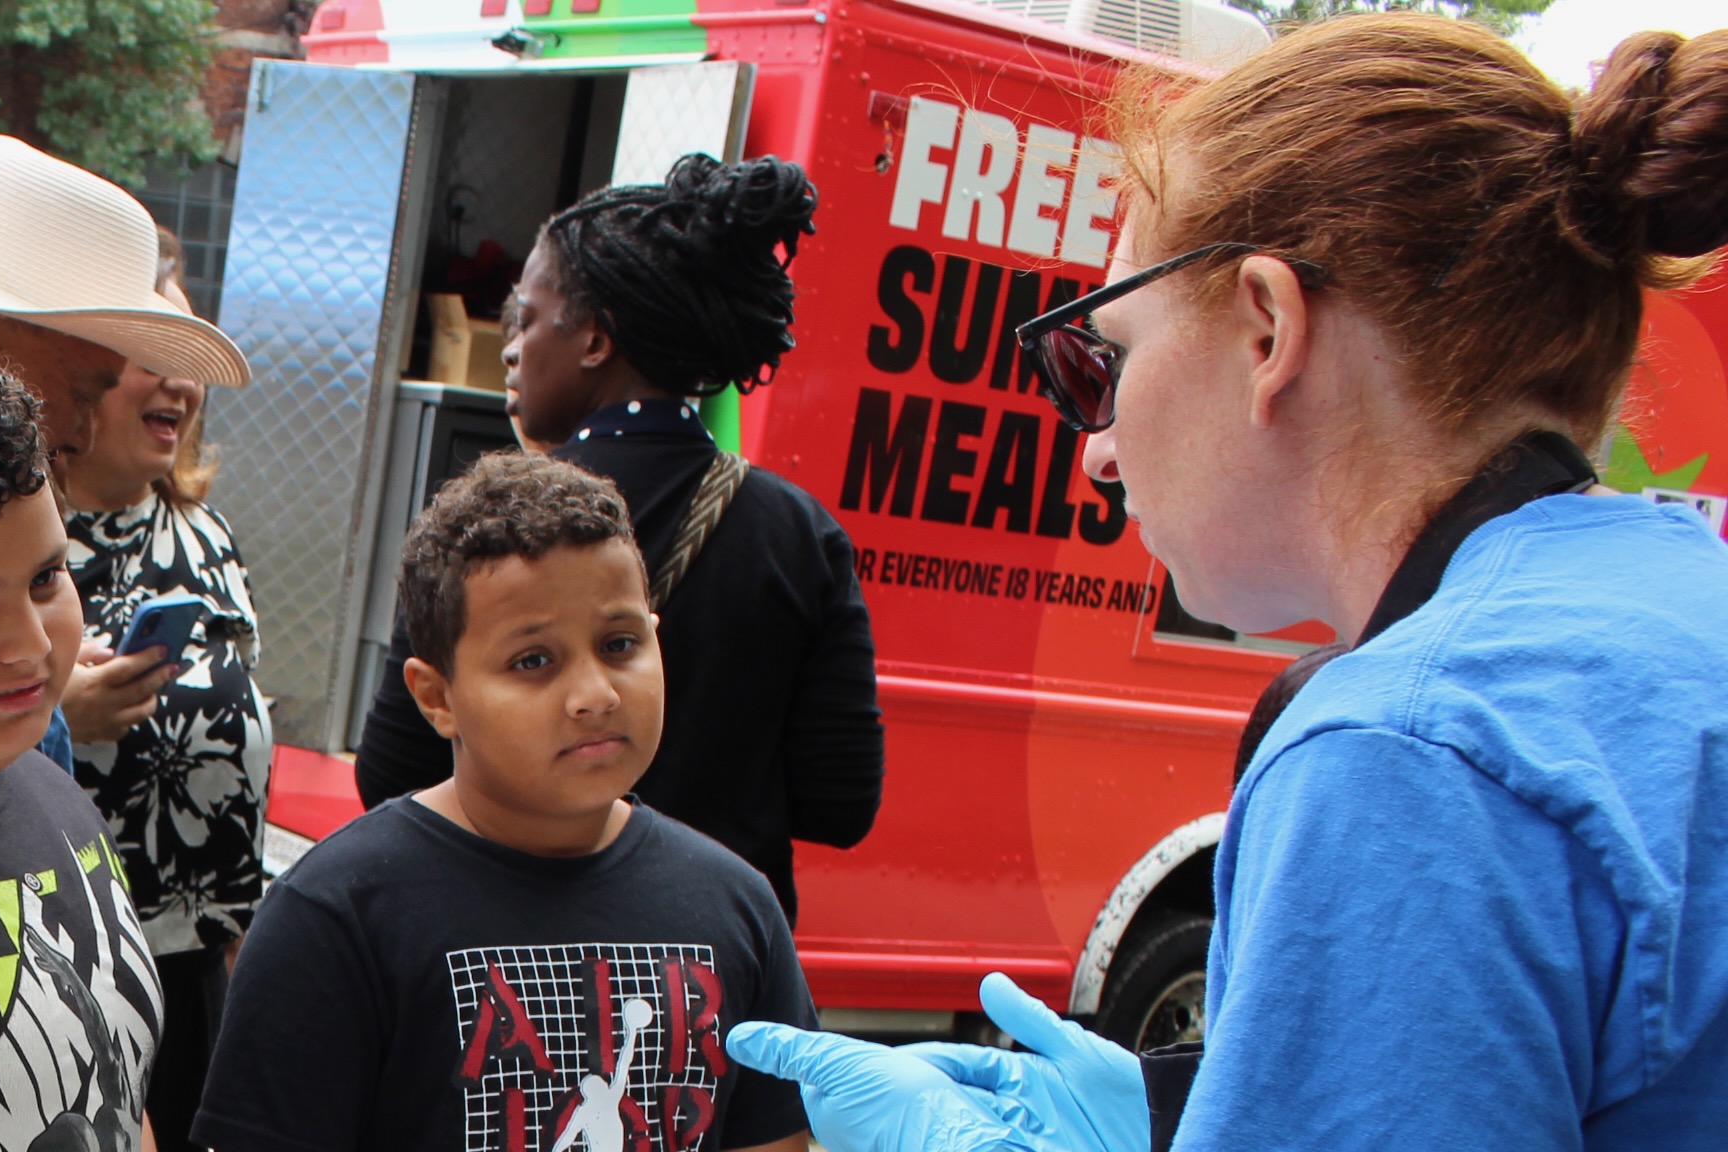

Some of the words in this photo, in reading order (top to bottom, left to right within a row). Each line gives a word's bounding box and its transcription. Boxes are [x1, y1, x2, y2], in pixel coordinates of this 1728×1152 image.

[888, 95, 1124, 268] FREE
[867, 245, 1103, 399] SUM
[880, 552, 1002, 596] EVERYONE
[1006, 568, 1029, 600] 18
[1034, 571, 1105, 607] YEARS
[1107, 580, 1156, 615] AND
[451, 956, 728, 1089] AIR
